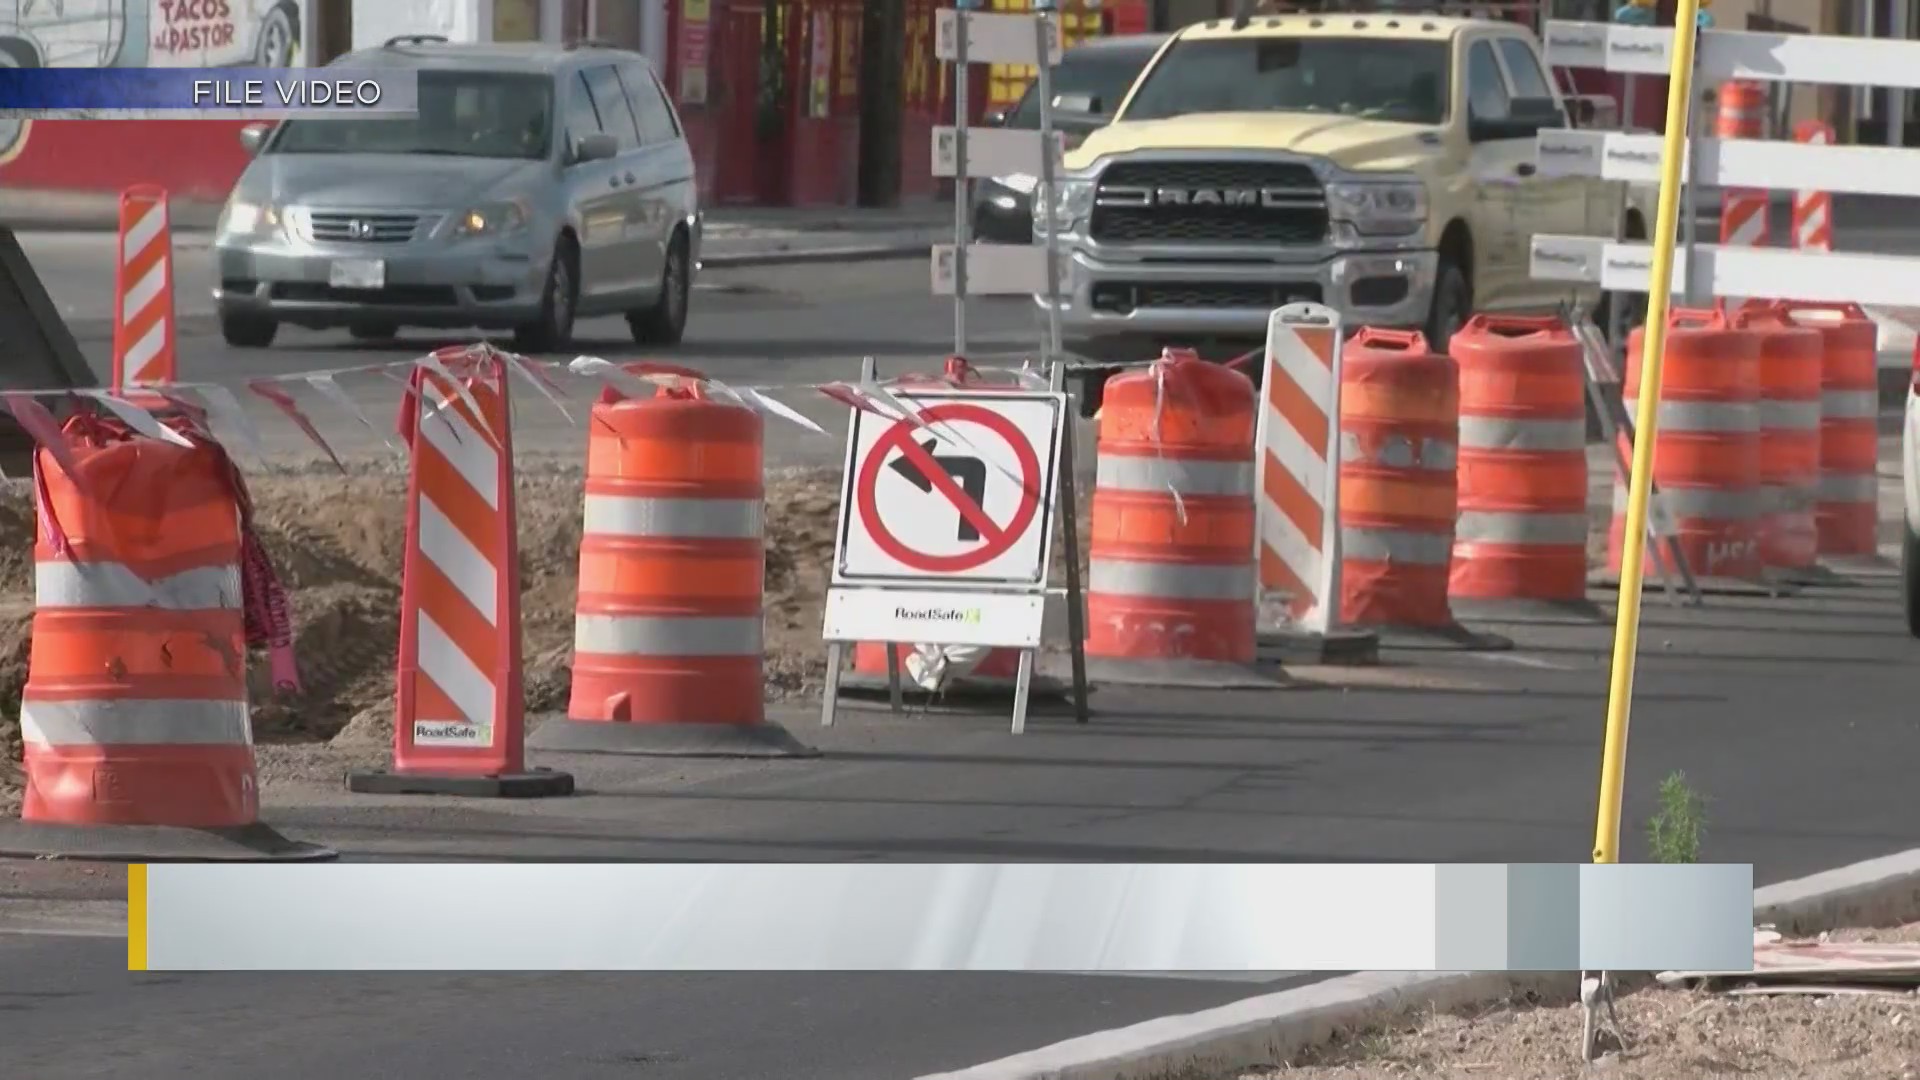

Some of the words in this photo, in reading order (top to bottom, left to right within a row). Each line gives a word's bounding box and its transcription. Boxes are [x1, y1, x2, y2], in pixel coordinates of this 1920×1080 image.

[160, 0, 230, 24] TACOS
[169, 23, 235, 52] PASTOR
[1157, 188, 1257, 206] RAM
[895, 607, 964, 620] RoadSafe
[416, 726, 477, 738] RoadSafe
